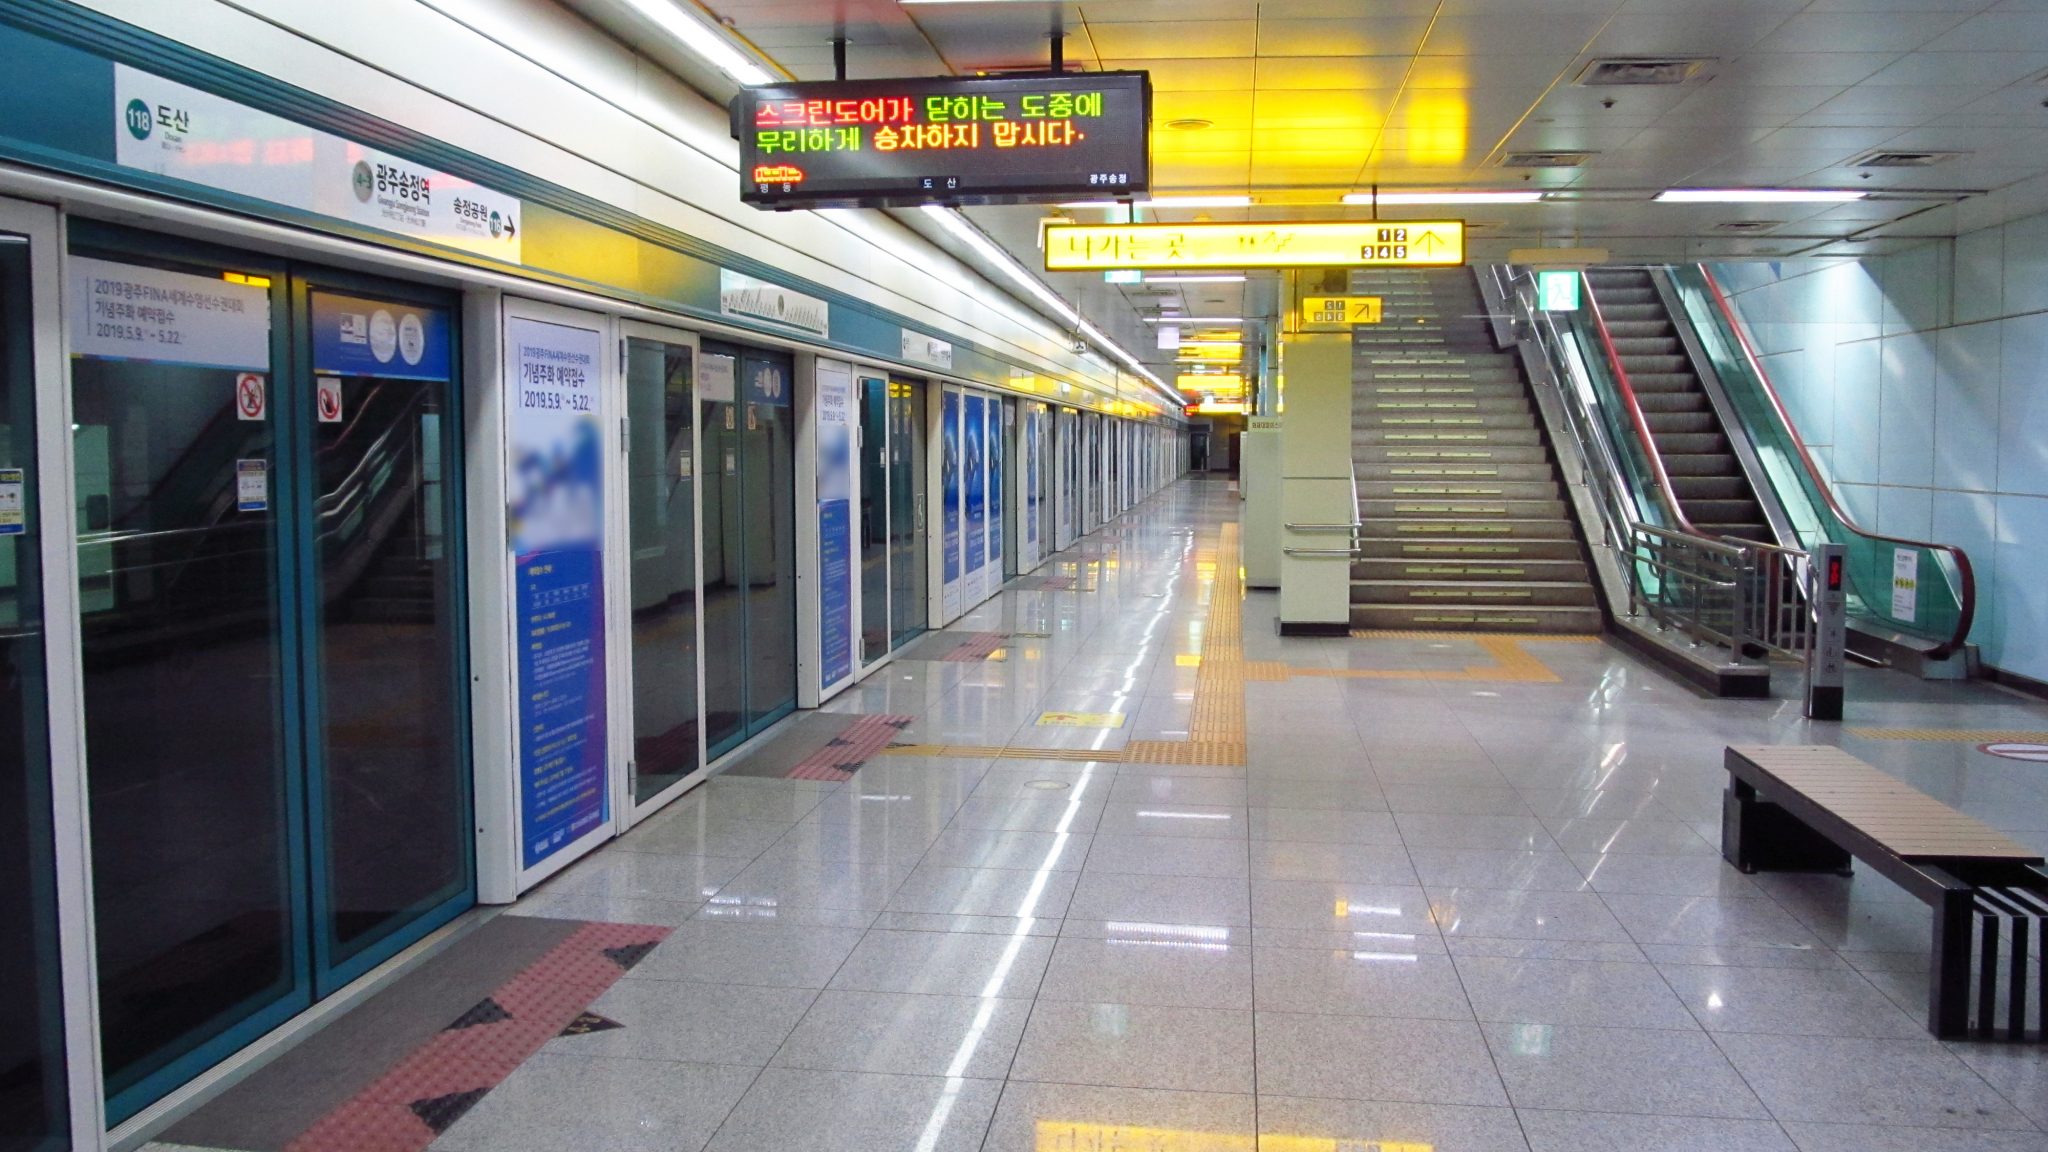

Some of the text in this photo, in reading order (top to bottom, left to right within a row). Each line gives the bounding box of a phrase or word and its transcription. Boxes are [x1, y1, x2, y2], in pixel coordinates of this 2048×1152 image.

[127, 104, 190, 134] 118 도산
[756, 92, 1102, 126] 스크린도어가 닫히는 도중에
[756, 126, 860, 154] 무리하게
[874, 124, 978, 150] 승차하지
[375, 162, 431, 206] 광주송정역
[1089, 173, 1128, 184] 광주송정
[453, 196, 488, 223] 송정공원
[490, 217, 502, 234] 116
[1069, 233, 1185, 261] 나가는 곳
[1381, 229, 1405, 241] 1 2
[1363, 246, 1405, 259] 3 4 5
[94, 301, 135, 321] 기념주화
[523, 362, 586, 389] 기념주화 예약접수
